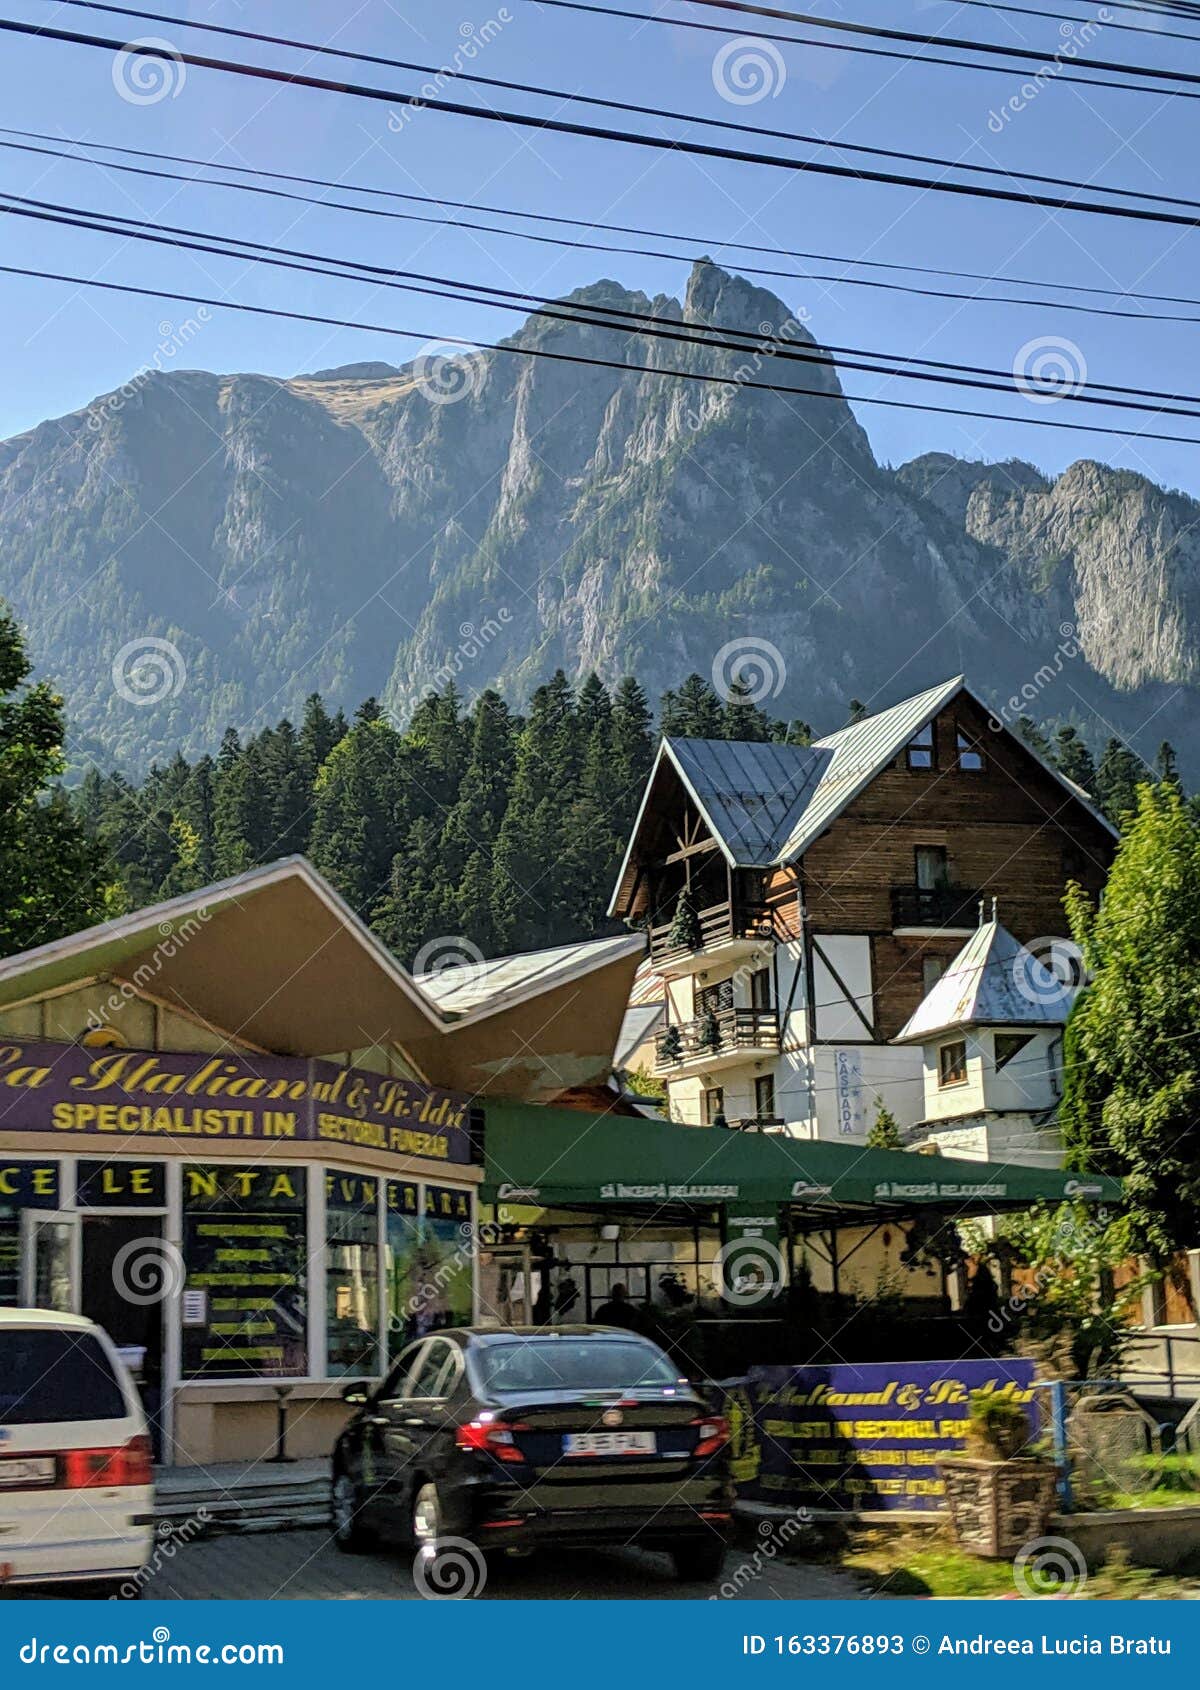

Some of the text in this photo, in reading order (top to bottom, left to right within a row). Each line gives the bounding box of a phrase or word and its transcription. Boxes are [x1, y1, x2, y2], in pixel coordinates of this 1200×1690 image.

[52, 1102, 253, 1136] SPECIALISTI
[263, 1111, 296, 1137] IN
[838, 1052, 852, 1133] CASCADA
